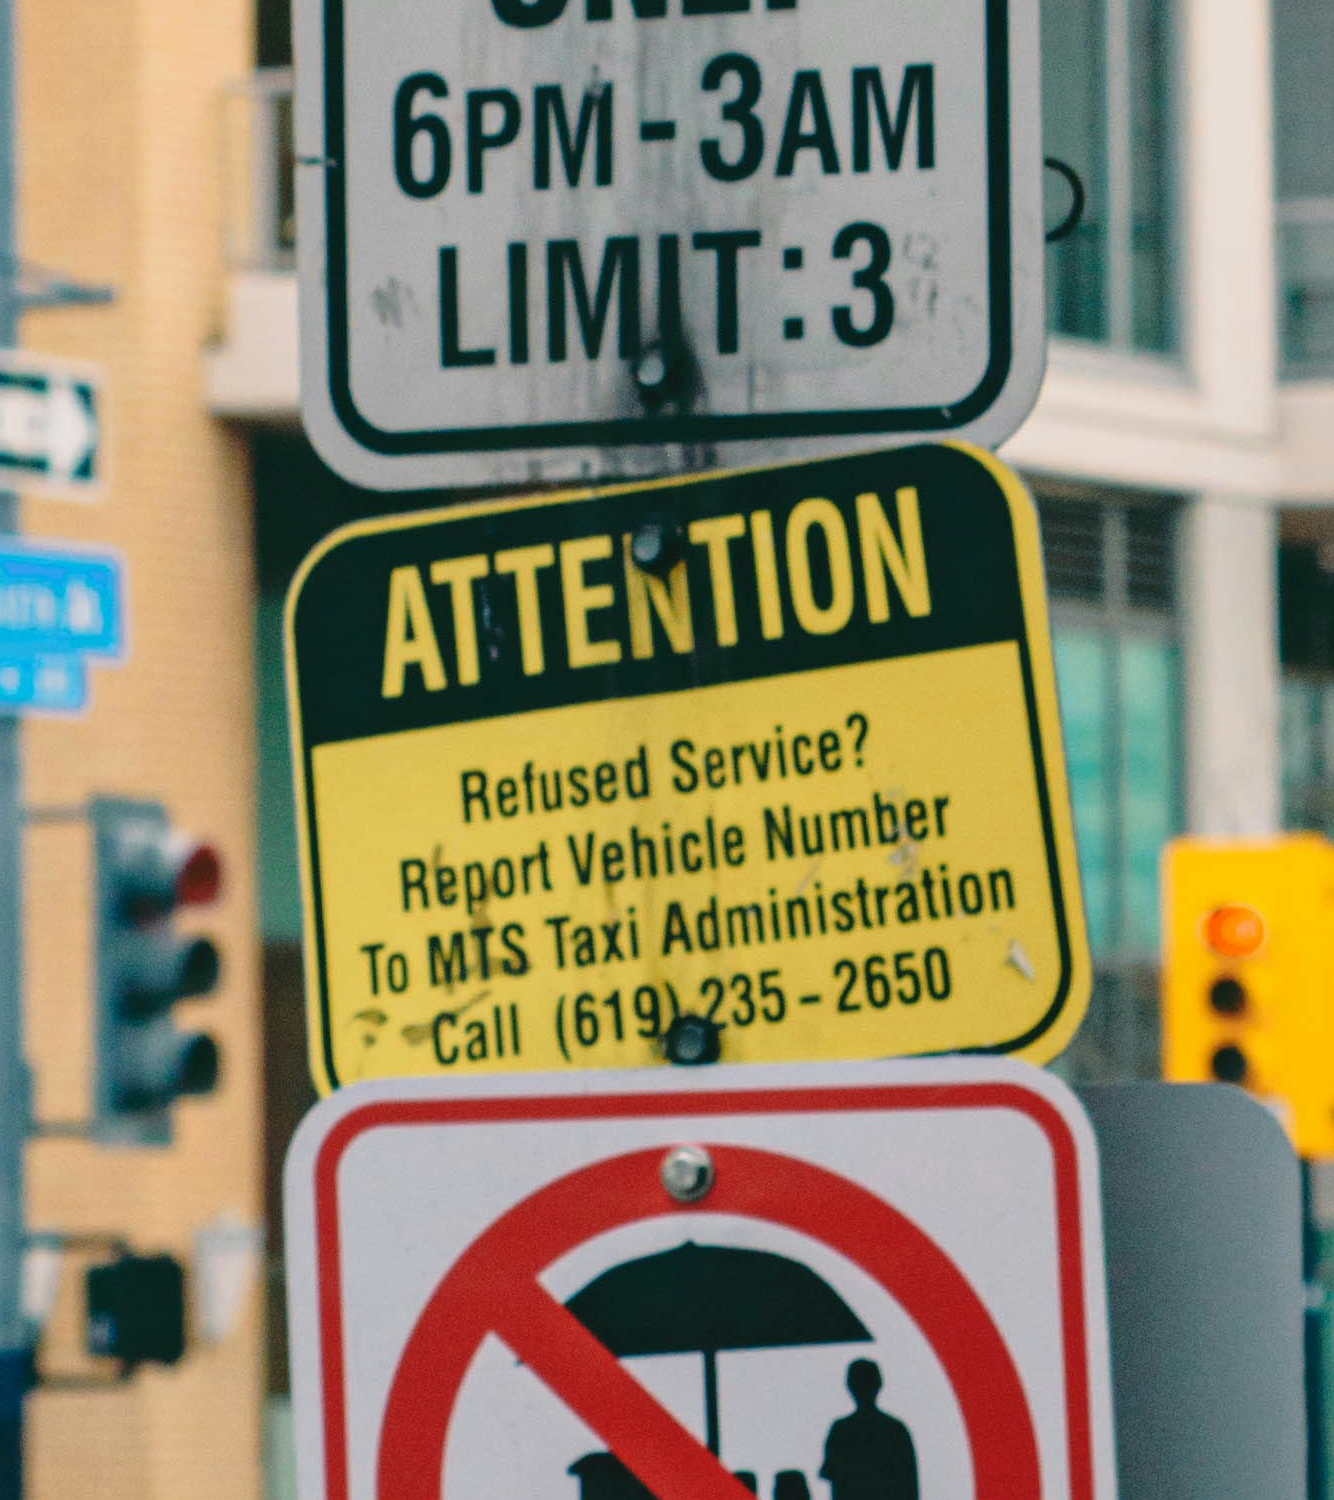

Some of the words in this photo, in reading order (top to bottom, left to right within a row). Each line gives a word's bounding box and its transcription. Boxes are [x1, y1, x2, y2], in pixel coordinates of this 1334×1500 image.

[381, 486, 932, 698] ATTENTION
[460, 746, 651, 823] Refused
[672, 713, 870, 793] Service?
[400, 842, 552, 914] Report
[569, 820, 746, 888] Vehicle
[763, 792, 951, 861] Number
[361, 943, 409, 997] To
[428, 922, 528, 985] MTS
[546, 914, 640, 970] Taxi
[662, 866, 1017, 956] Administration
[431, 1003, 522, 1066] Call
[554, 979, 681, 1062] (619)
